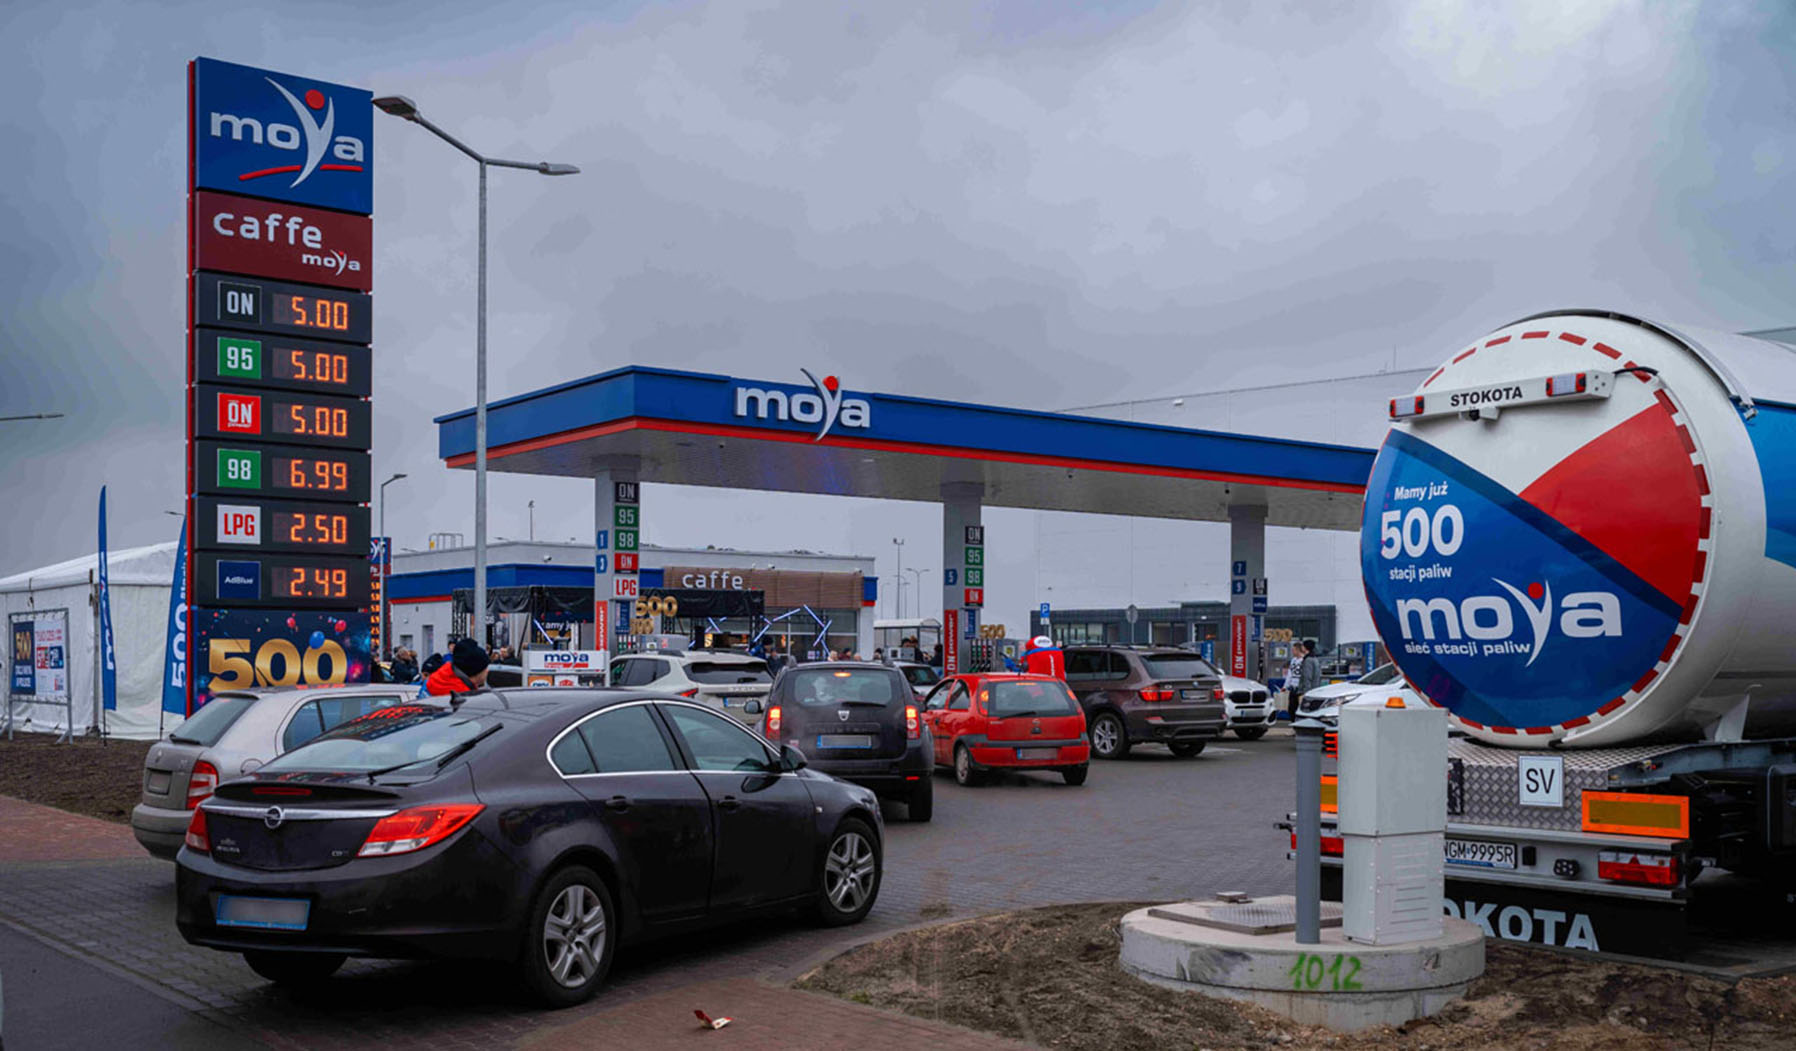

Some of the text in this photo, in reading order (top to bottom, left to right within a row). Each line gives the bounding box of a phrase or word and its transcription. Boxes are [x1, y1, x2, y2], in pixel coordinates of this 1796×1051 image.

[210, 76, 364, 188] moya
[213, 212, 322, 248] caffe
[302, 250, 361, 275] moya
[226, 291, 348, 331] ON 5.00
[226, 346, 347, 384] 95 5.00
[735, 368, 871, 442] moya
[1450, 386, 1523, 407] STOKOTA
[228, 402, 347, 437] ON 5.00
[228, 458, 347, 491] 98 6.99
[619, 483, 635, 499] ON
[1394, 481, 1448, 501] Mamy już
[224, 512, 347, 544] LPG 2.50
[618, 509, 635, 524] 95
[618, 532, 635, 548] 98
[1380, 504, 1464, 560] 500
[968, 549, 980, 563] 95
[224, 575, 254, 585] AdBlue
[290, 568, 347, 597] 2.49
[682, 570, 744, 590] caffe
[968, 569, 980, 584] 98
[1389, 563, 1453, 583] stacji paliw
[615, 579, 637, 596] LPG
[1041, 604, 1049, 614] P
[1395, 576, 1623, 668] moya
[543, 650, 589, 668] moya
[1433, 641, 1478, 657] stacji
[1482, 641, 1531, 657] paliw
[208, 638, 348, 692] 500
[1525, 767, 1555, 794] SV
[1470, 843, 1515, 864] 9995R
[1289, 952, 1362, 990] 1012
